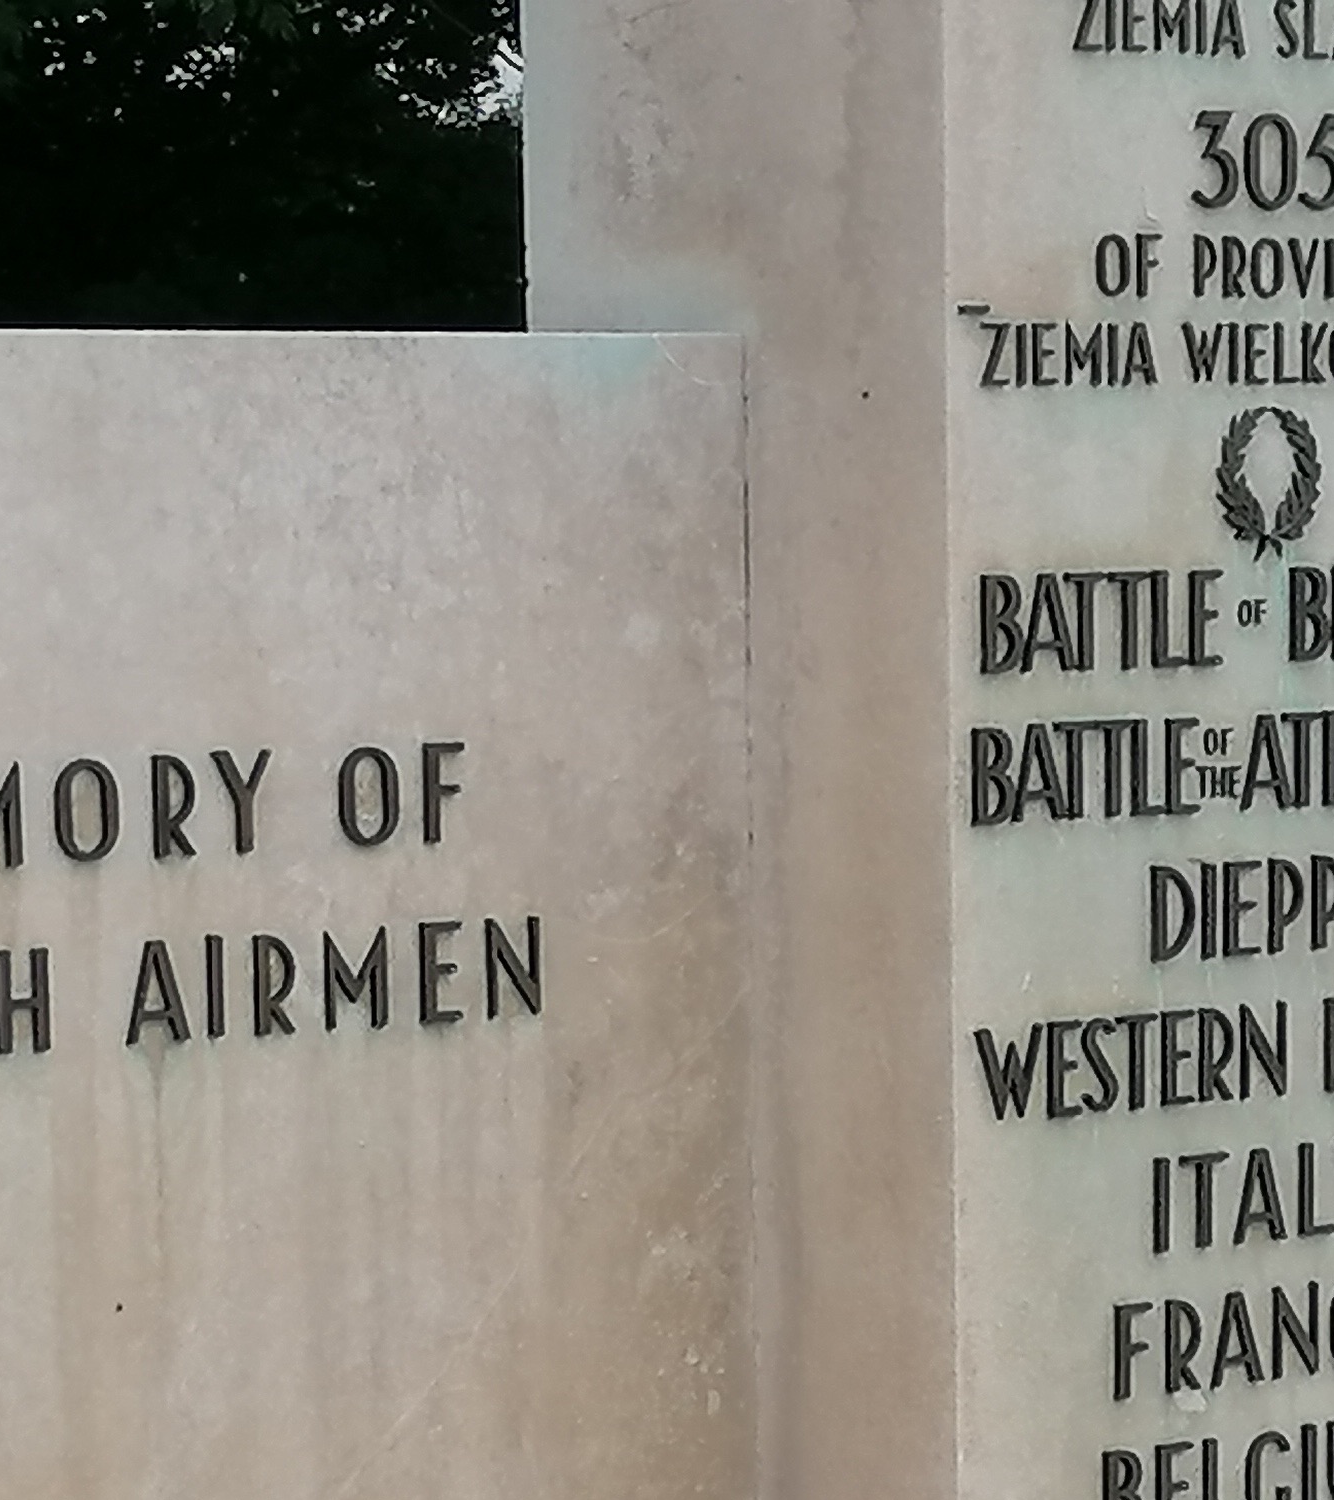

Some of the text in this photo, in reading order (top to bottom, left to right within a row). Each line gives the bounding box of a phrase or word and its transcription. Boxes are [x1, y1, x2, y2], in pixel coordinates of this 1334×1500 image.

[1073, 0, 1245, 59] ZIEMIA
[1095, 233, 1162, 299] OF
[980, 319, 1158, 389] ZIEMIA
[980, 569, 1223, 676] BATTLE
[1237, 599, 1267, 627] OF
[970, 717, 1202, 828] BATTLE
[1196, 765, 1241, 800] THE
[1203, 728, 1233, 756] OF
[338, 742, 464, 848] OF
[126, 916, 541, 1047] AIRMEN
[973, 1000, 1287, 1121] WESTERN
